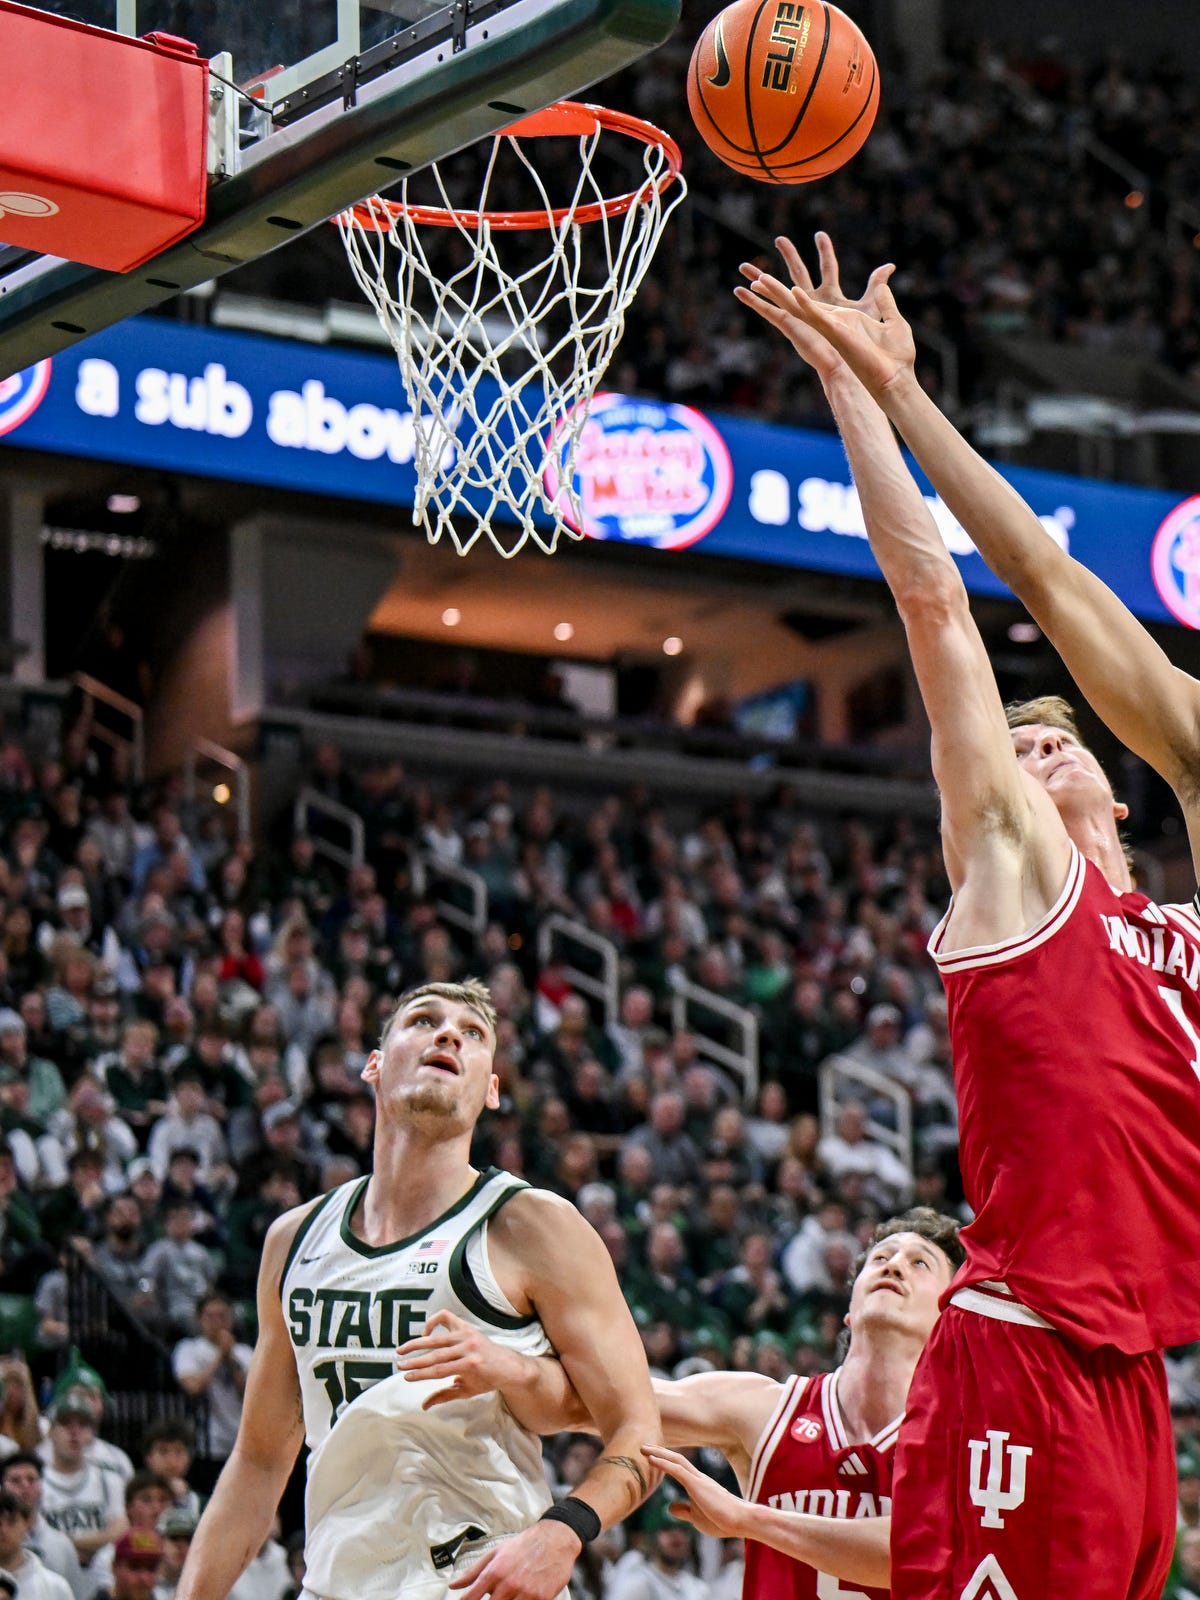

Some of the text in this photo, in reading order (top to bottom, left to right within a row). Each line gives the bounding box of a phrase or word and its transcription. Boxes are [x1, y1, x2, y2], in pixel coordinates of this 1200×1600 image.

[761, 2, 805, 93] ELITE
[75, 358, 120, 417] a
[134, 362, 253, 438] sub
[288, 1287, 434, 1348] STATE
[797, 1417, 822, 1440] 76
